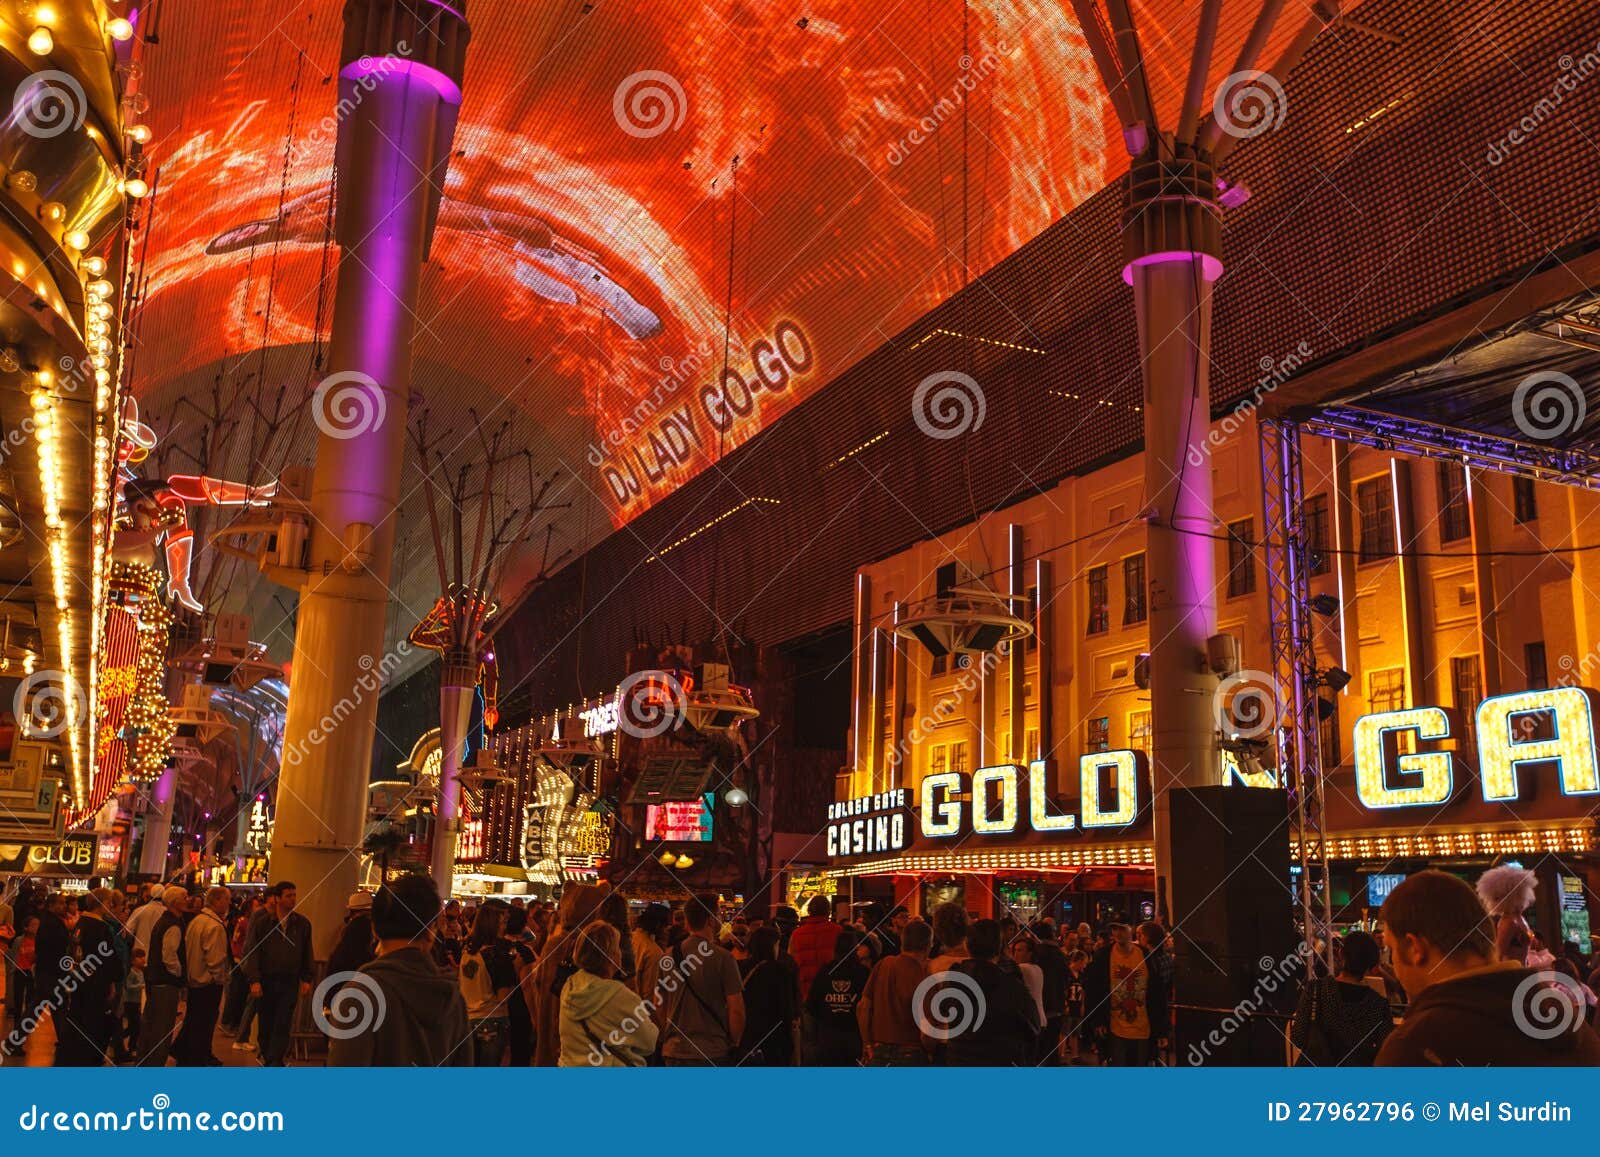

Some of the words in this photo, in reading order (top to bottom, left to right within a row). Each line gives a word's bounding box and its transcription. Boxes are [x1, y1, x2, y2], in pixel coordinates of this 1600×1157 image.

[602, 455, 642, 507] DJ
[632, 404, 703, 484] LADY
[700, 318, 813, 434] GO-GO
[1354, 686, 1600, 809] GA
[874, 788, 904, 811] GATE
[63, 841, 92, 849] MEN'S
[526, 810, 542, 855] ABC
[827, 813, 904, 857] CASINO
[29, 846, 91, 865] CLUB
